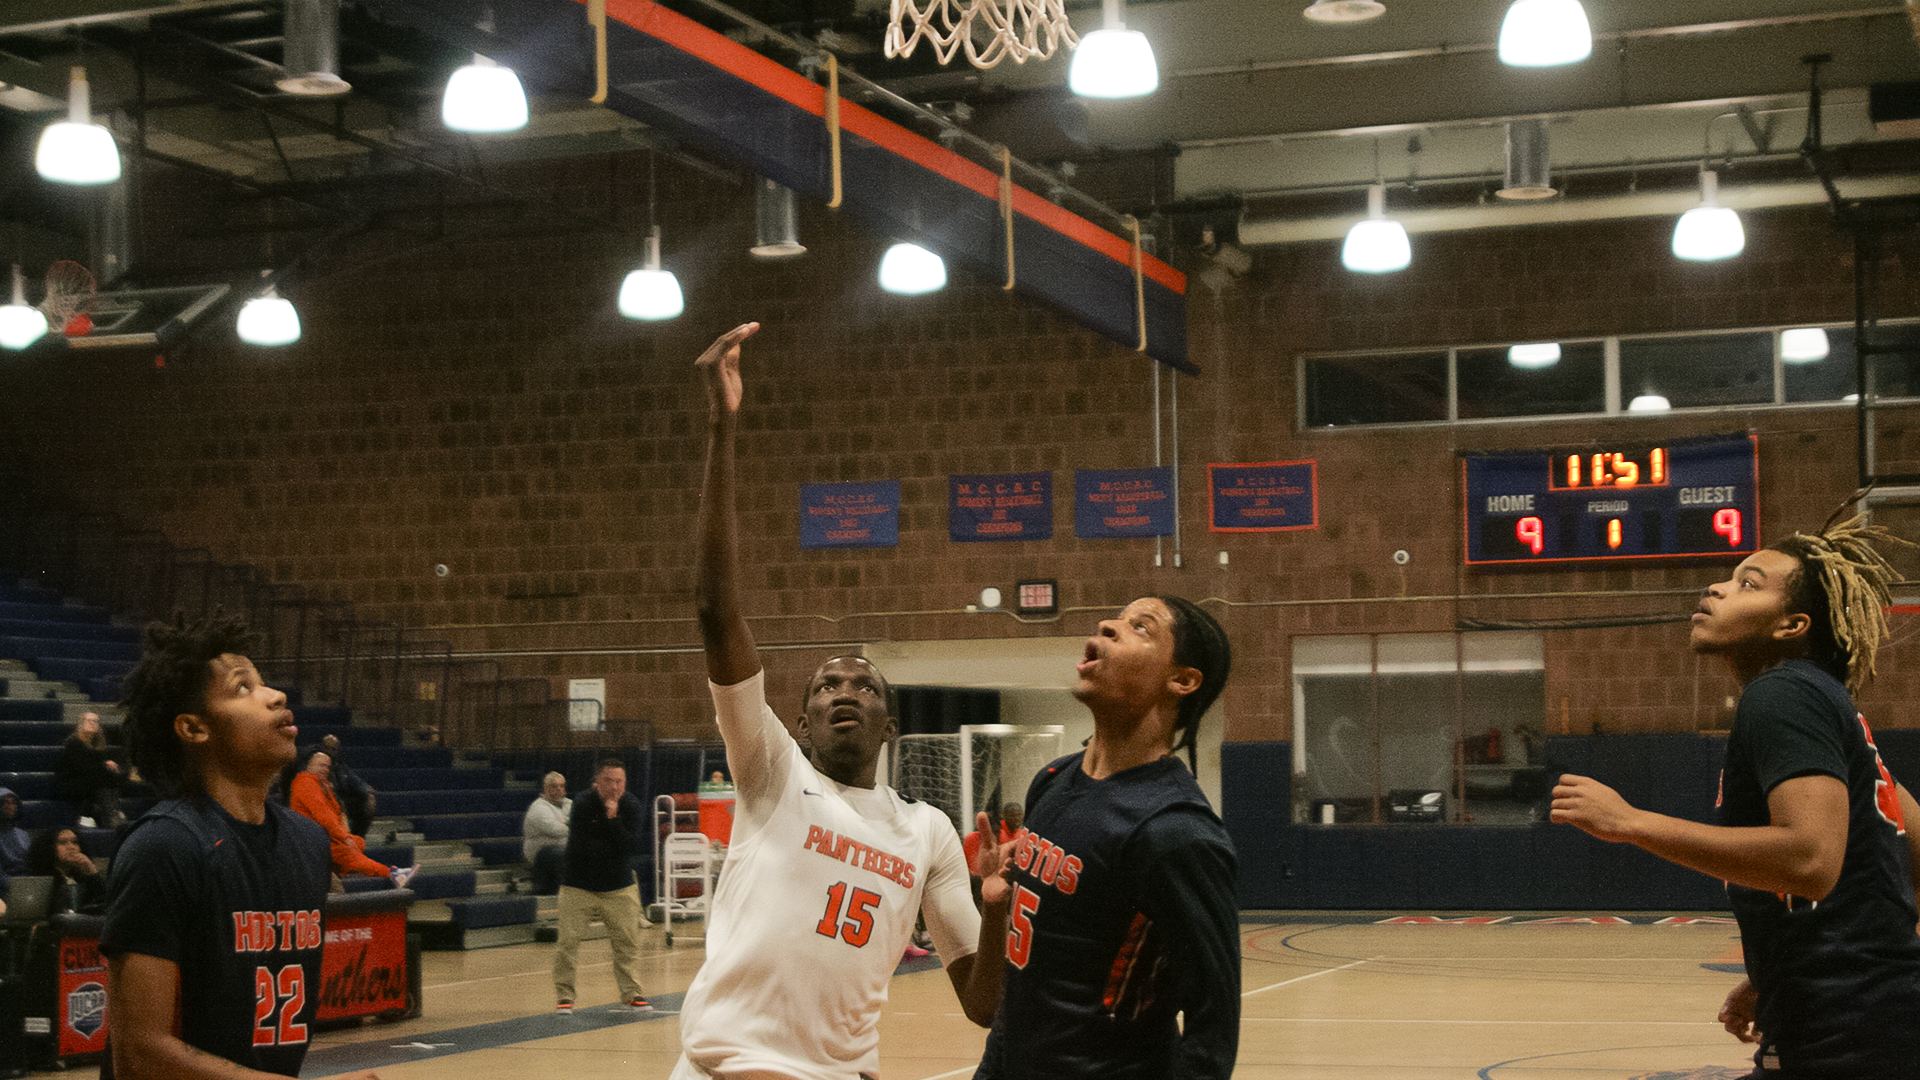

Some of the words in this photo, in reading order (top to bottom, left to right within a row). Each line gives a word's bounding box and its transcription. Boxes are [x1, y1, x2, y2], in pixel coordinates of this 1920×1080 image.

[1567, 448, 1665, 489] 11:51
[1487, 494, 1535, 513] HOME
[1587, 500, 1629, 513] PERIOD
[1679, 486, 1736, 505] GUEST
[1516, 516, 1544, 555] 9
[1607, 519, 1622, 549] 1
[1715, 508, 1742, 547] 9
[803, 824, 917, 890] PANTHERS
[232, 909, 322, 953] HOSTOS
[815, 880, 883, 949] 15
[252, 963, 308, 1048] 22
